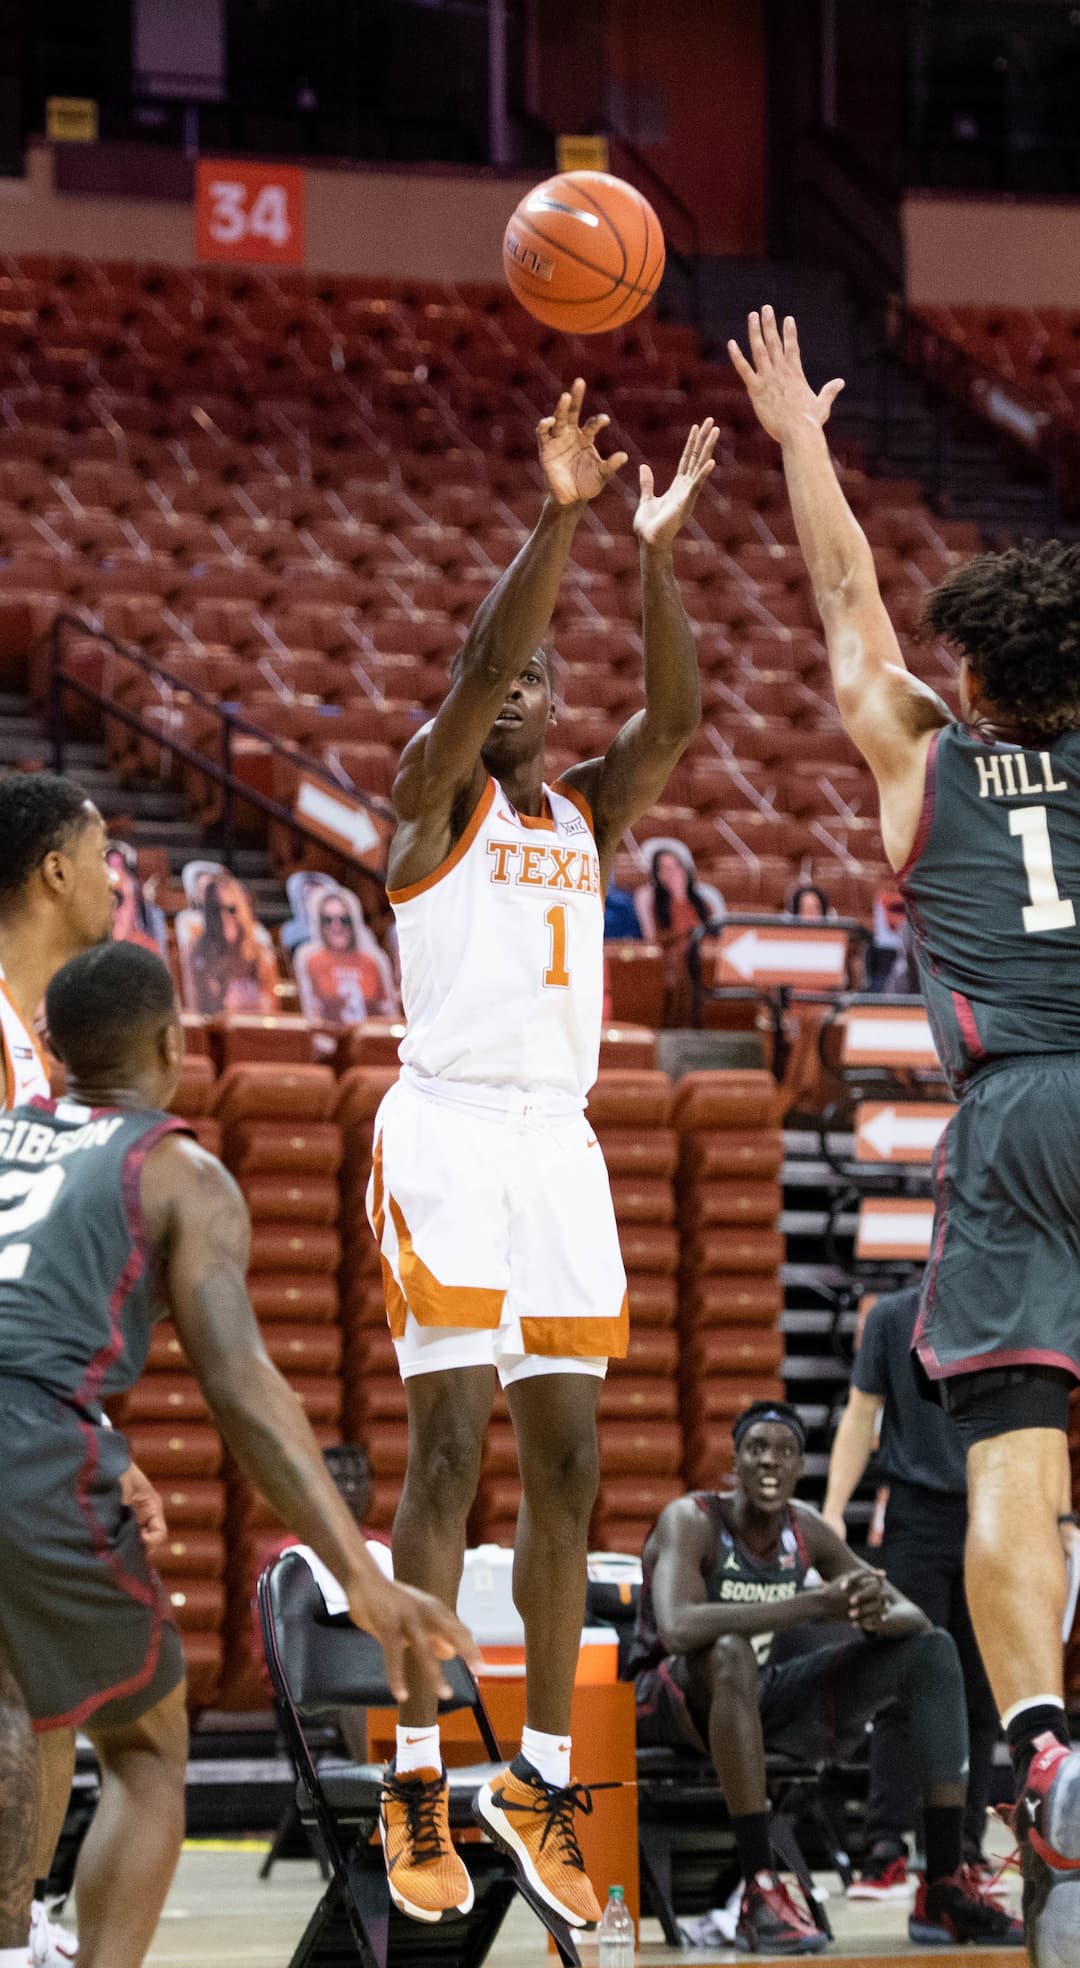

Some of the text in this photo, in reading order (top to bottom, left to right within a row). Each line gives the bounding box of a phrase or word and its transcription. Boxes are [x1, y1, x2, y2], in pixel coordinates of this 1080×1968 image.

[209, 182, 290, 246] 34
[975, 752, 1067, 797] HILL
[1009, 806, 1076, 932] 1
[542, 902, 571, 989] 1
[720, 1579, 797, 1602] SOONERS
